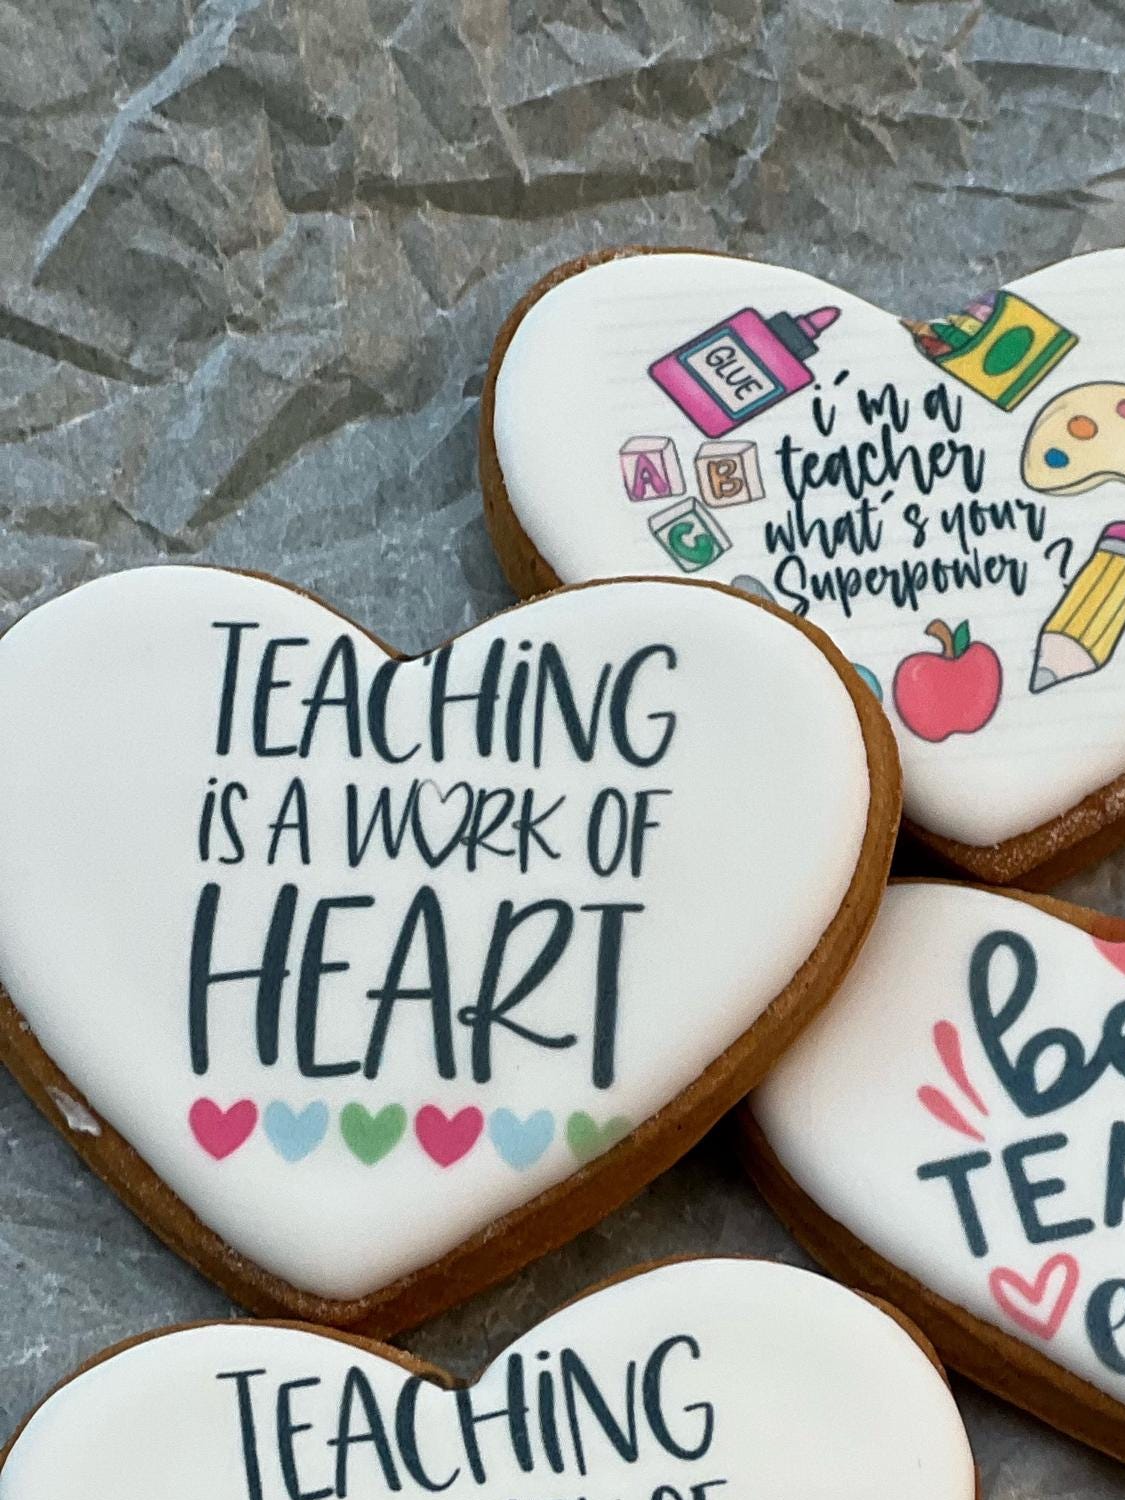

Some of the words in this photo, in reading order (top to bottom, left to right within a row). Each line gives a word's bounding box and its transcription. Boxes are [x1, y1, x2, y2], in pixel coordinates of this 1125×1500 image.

[704, 342, 764, 402] GLUE
[925, 382, 962, 434] a
[774, 424, 984, 500] teacher
[939, 499, 1046, 557] your
[266, 777, 311, 866] A
[587, 787, 673, 878] OF
[188, 882, 646, 1090] HEART
